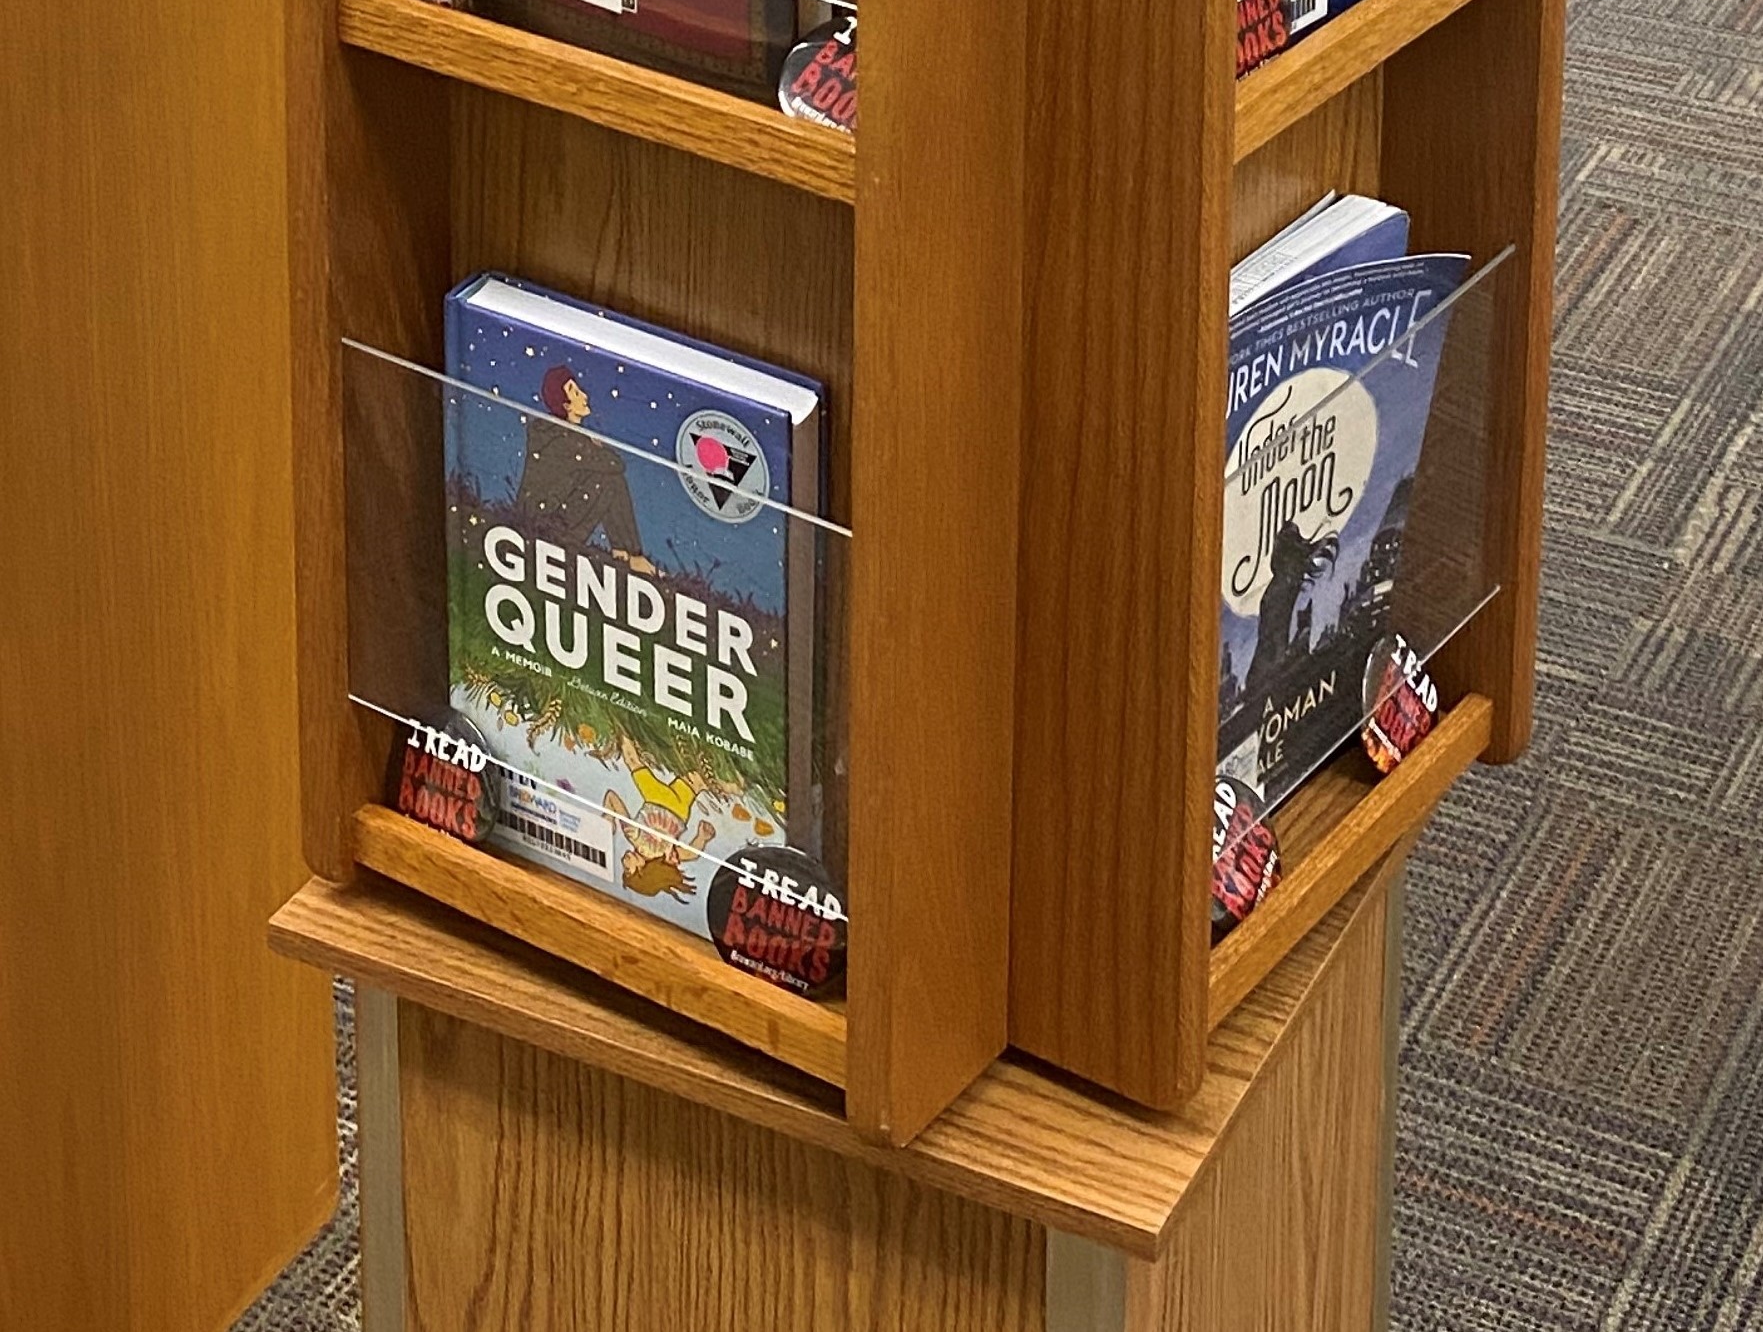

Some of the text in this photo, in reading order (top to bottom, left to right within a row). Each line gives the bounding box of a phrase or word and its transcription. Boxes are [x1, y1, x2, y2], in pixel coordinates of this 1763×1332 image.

[1286, 299, 1359, 336] BESTSELLING
[1362, 288, 1415, 308] AUTHOR
[1290, 289, 1432, 370] MYRACLE
[1238, 387, 1336, 496] Under the
[1232, 452, 1353, 595] Moon
[483, 525, 757, 676] GENDER
[484, 583, 756, 743] QUEER
[491, 646, 552, 677] A MEMOIR
[1391, 634, 1407, 666] I
[1403, 648, 1438, 712] READ
[1260, 670, 1336, 743] OMAN
[1263, 696, 1275, 719] A
[407, 718, 487, 773] I READ
[667, 717, 754, 762] MAIA KOBABE
[402, 746, 482, 801] BANNED
[399, 775, 478, 839] BOOKS
[732, 885, 836, 950] BANNED
[738, 857, 842, 921] I READ
[723, 912, 830, 983] BOOKS
